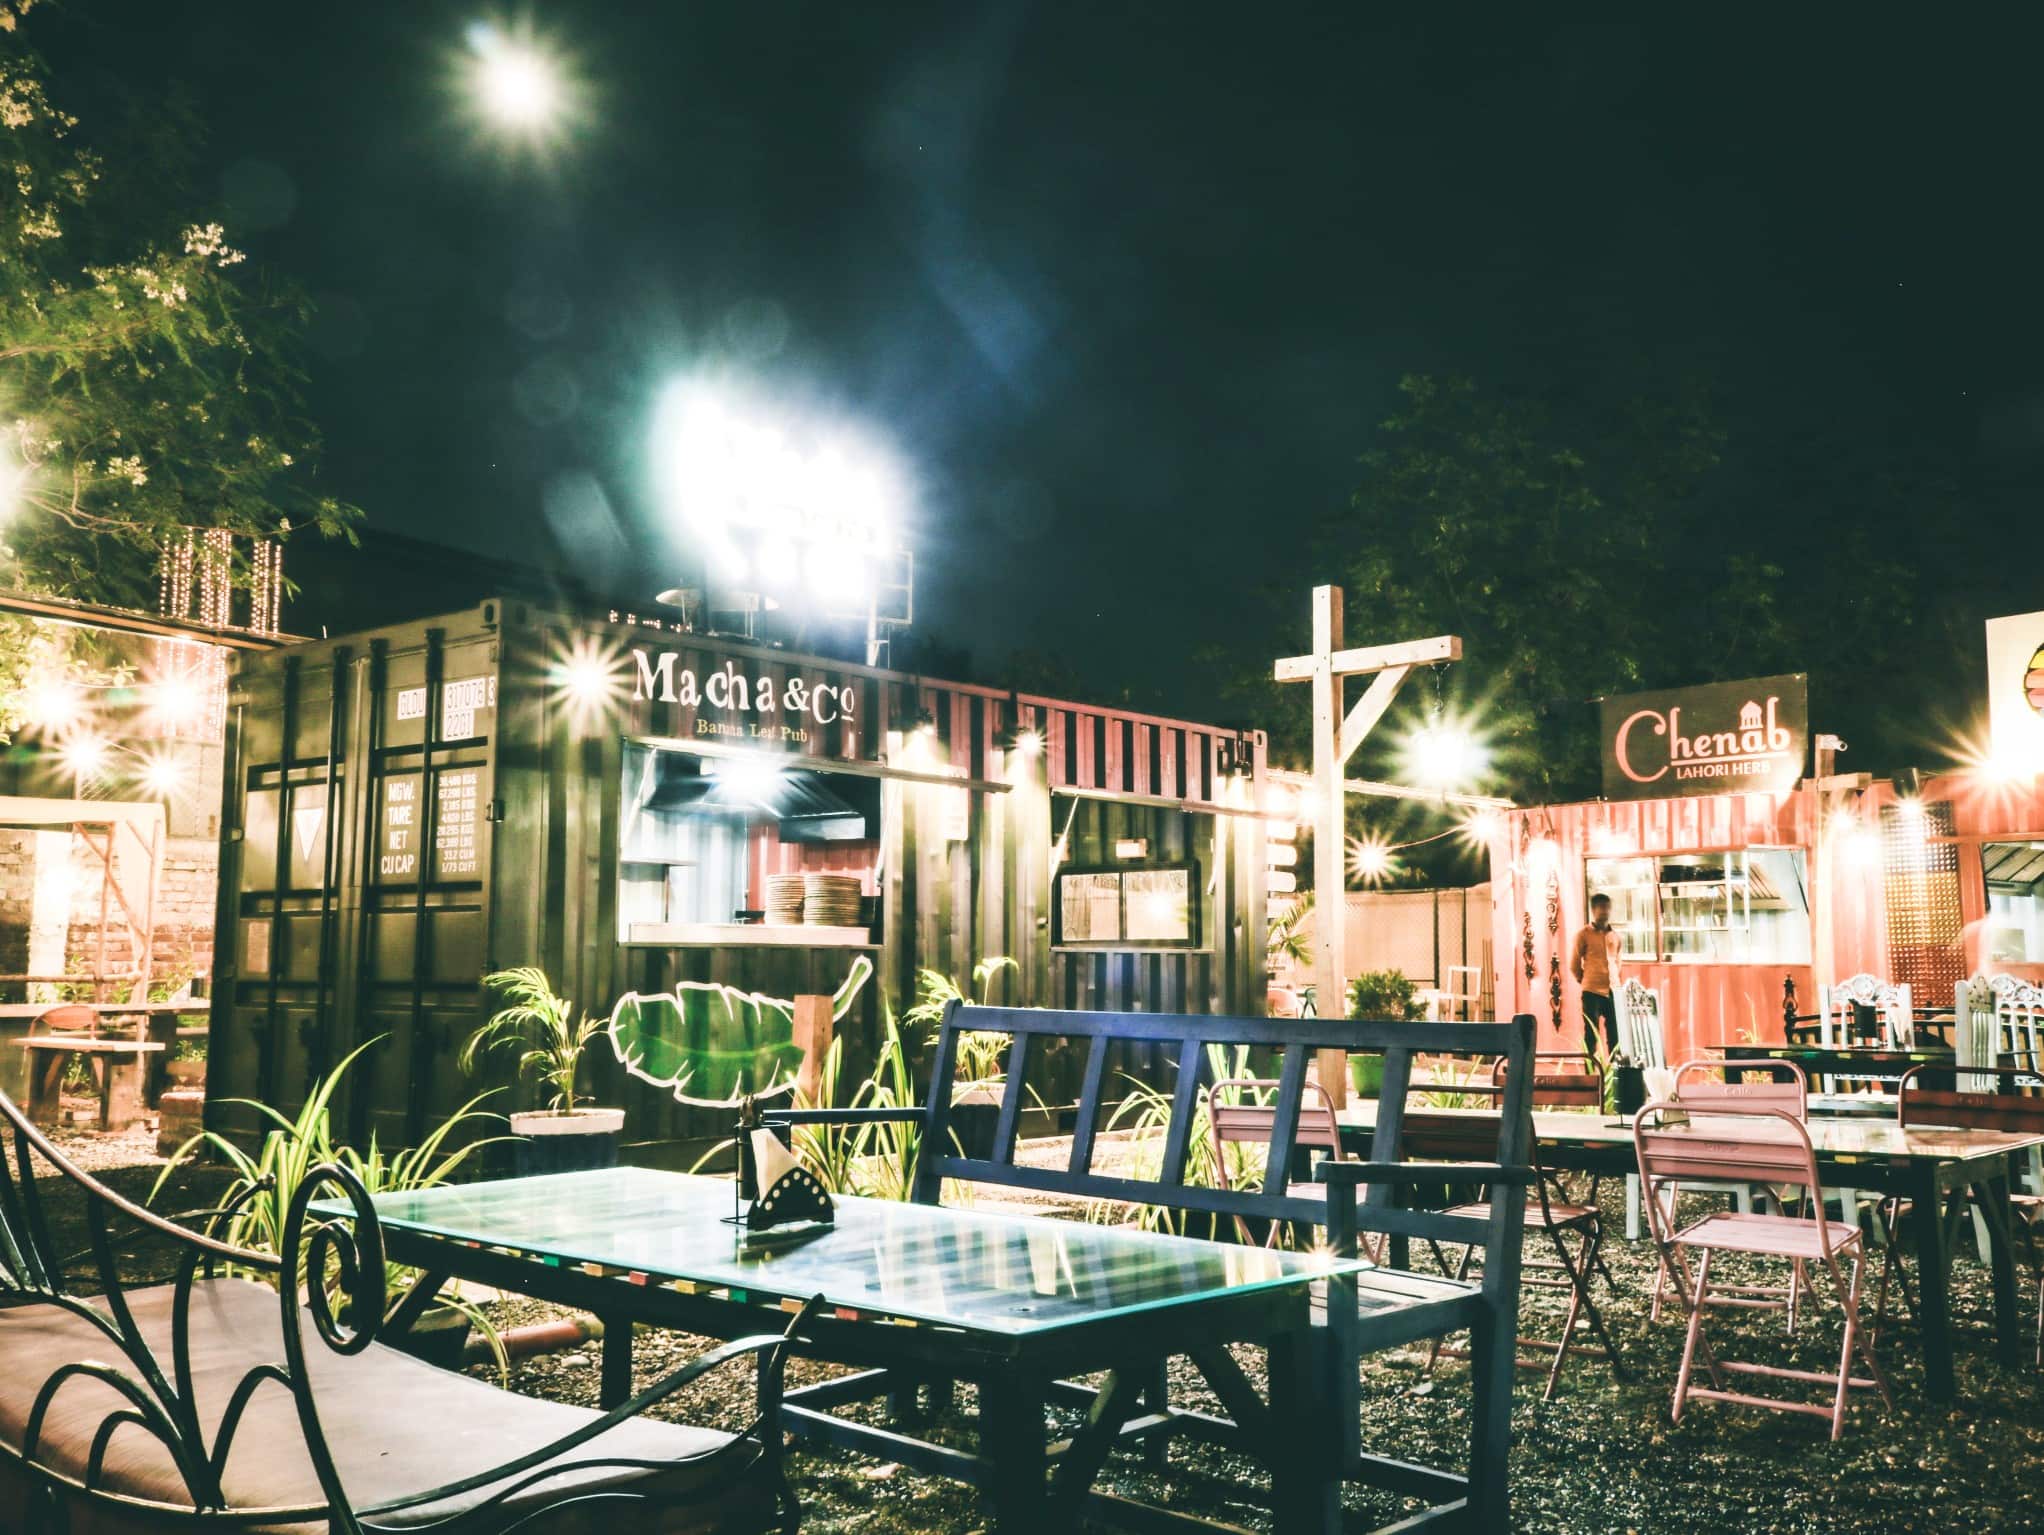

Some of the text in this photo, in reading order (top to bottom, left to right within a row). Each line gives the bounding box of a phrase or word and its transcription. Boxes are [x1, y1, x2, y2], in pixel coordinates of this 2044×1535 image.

[780, 726, 808, 743] Pub
[1615, 696, 1791, 783] Chenab
[1676, 764, 1729, 780] LAHORI
[389, 829, 409, 850] NET
[394, 853, 415, 874] CAP
